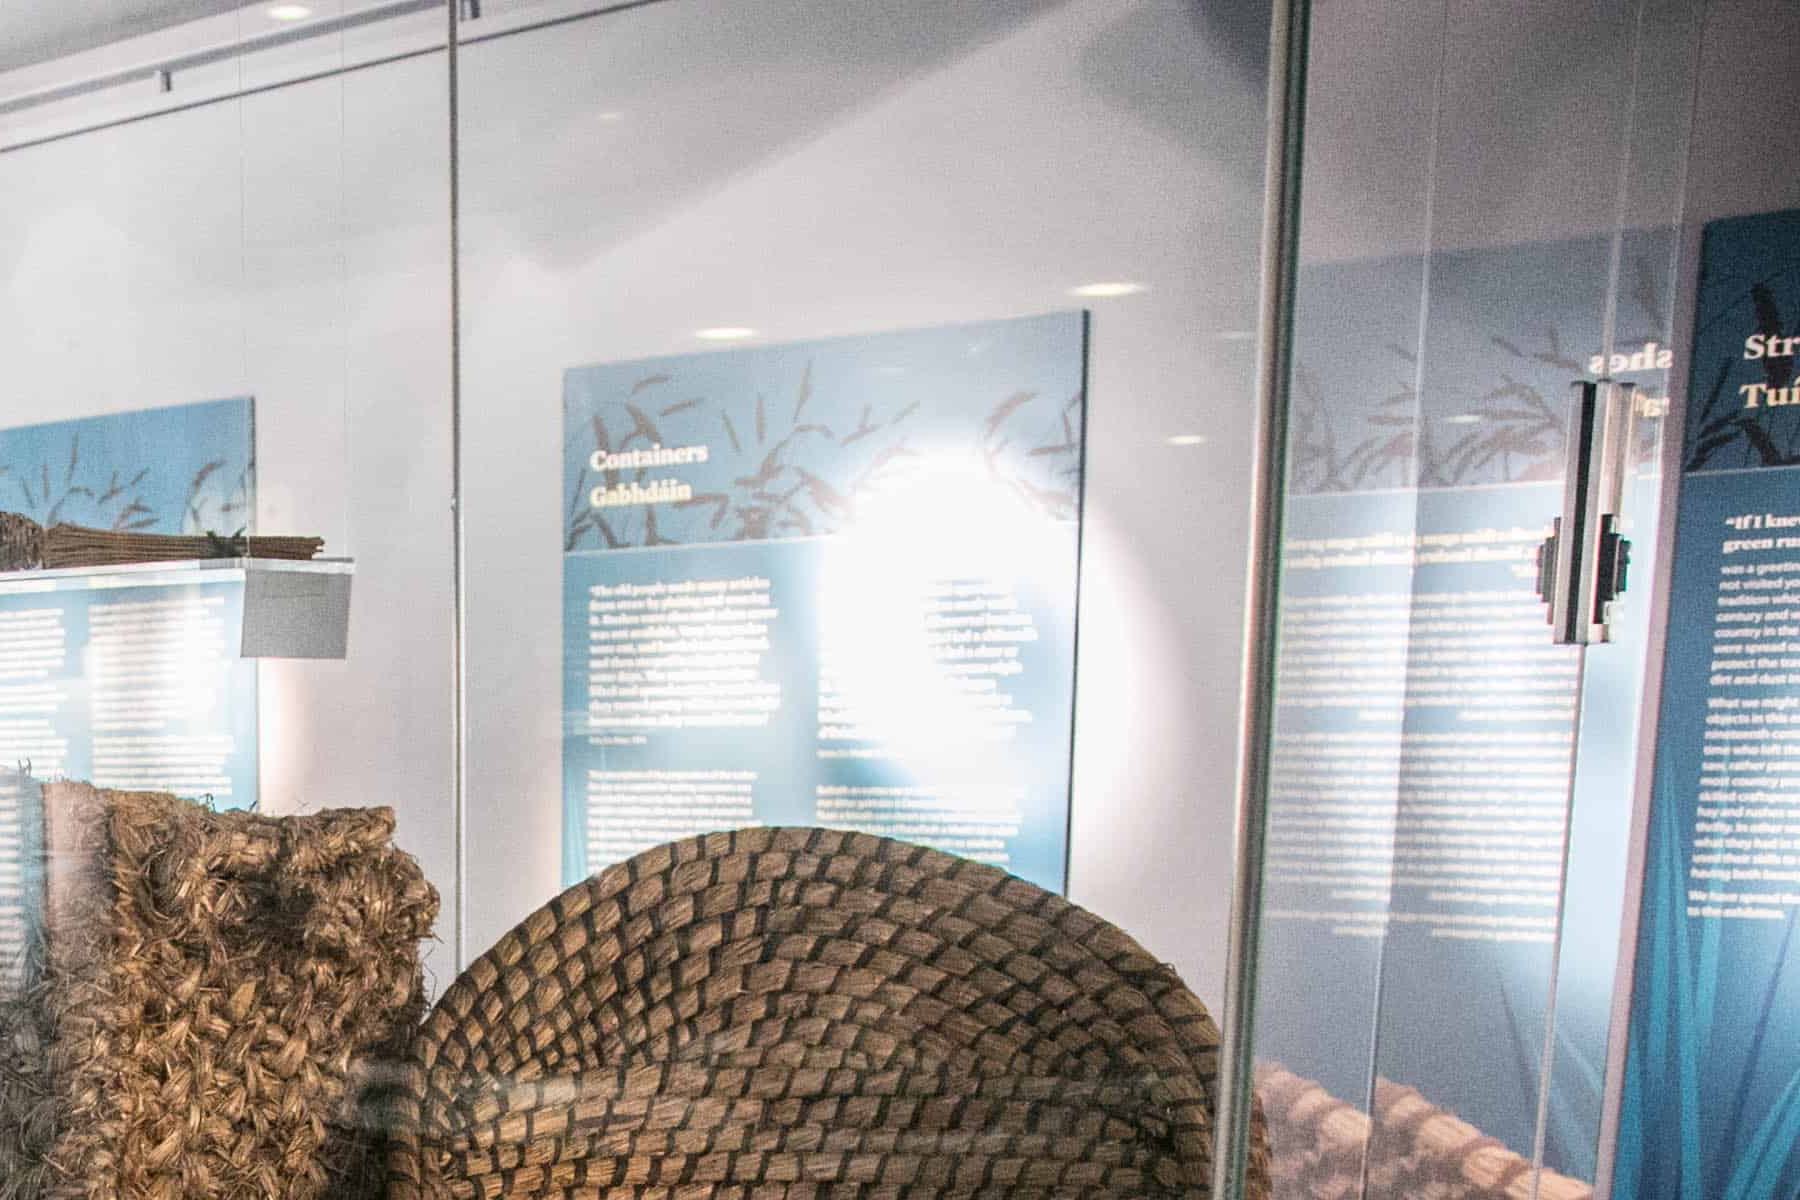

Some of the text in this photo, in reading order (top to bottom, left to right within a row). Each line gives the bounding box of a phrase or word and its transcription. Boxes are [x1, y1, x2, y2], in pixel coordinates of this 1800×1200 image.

[1743, 332, 1800, 360] Str
[589, 442, 709, 472] Containers
[1722, 538, 1774, 554] green
